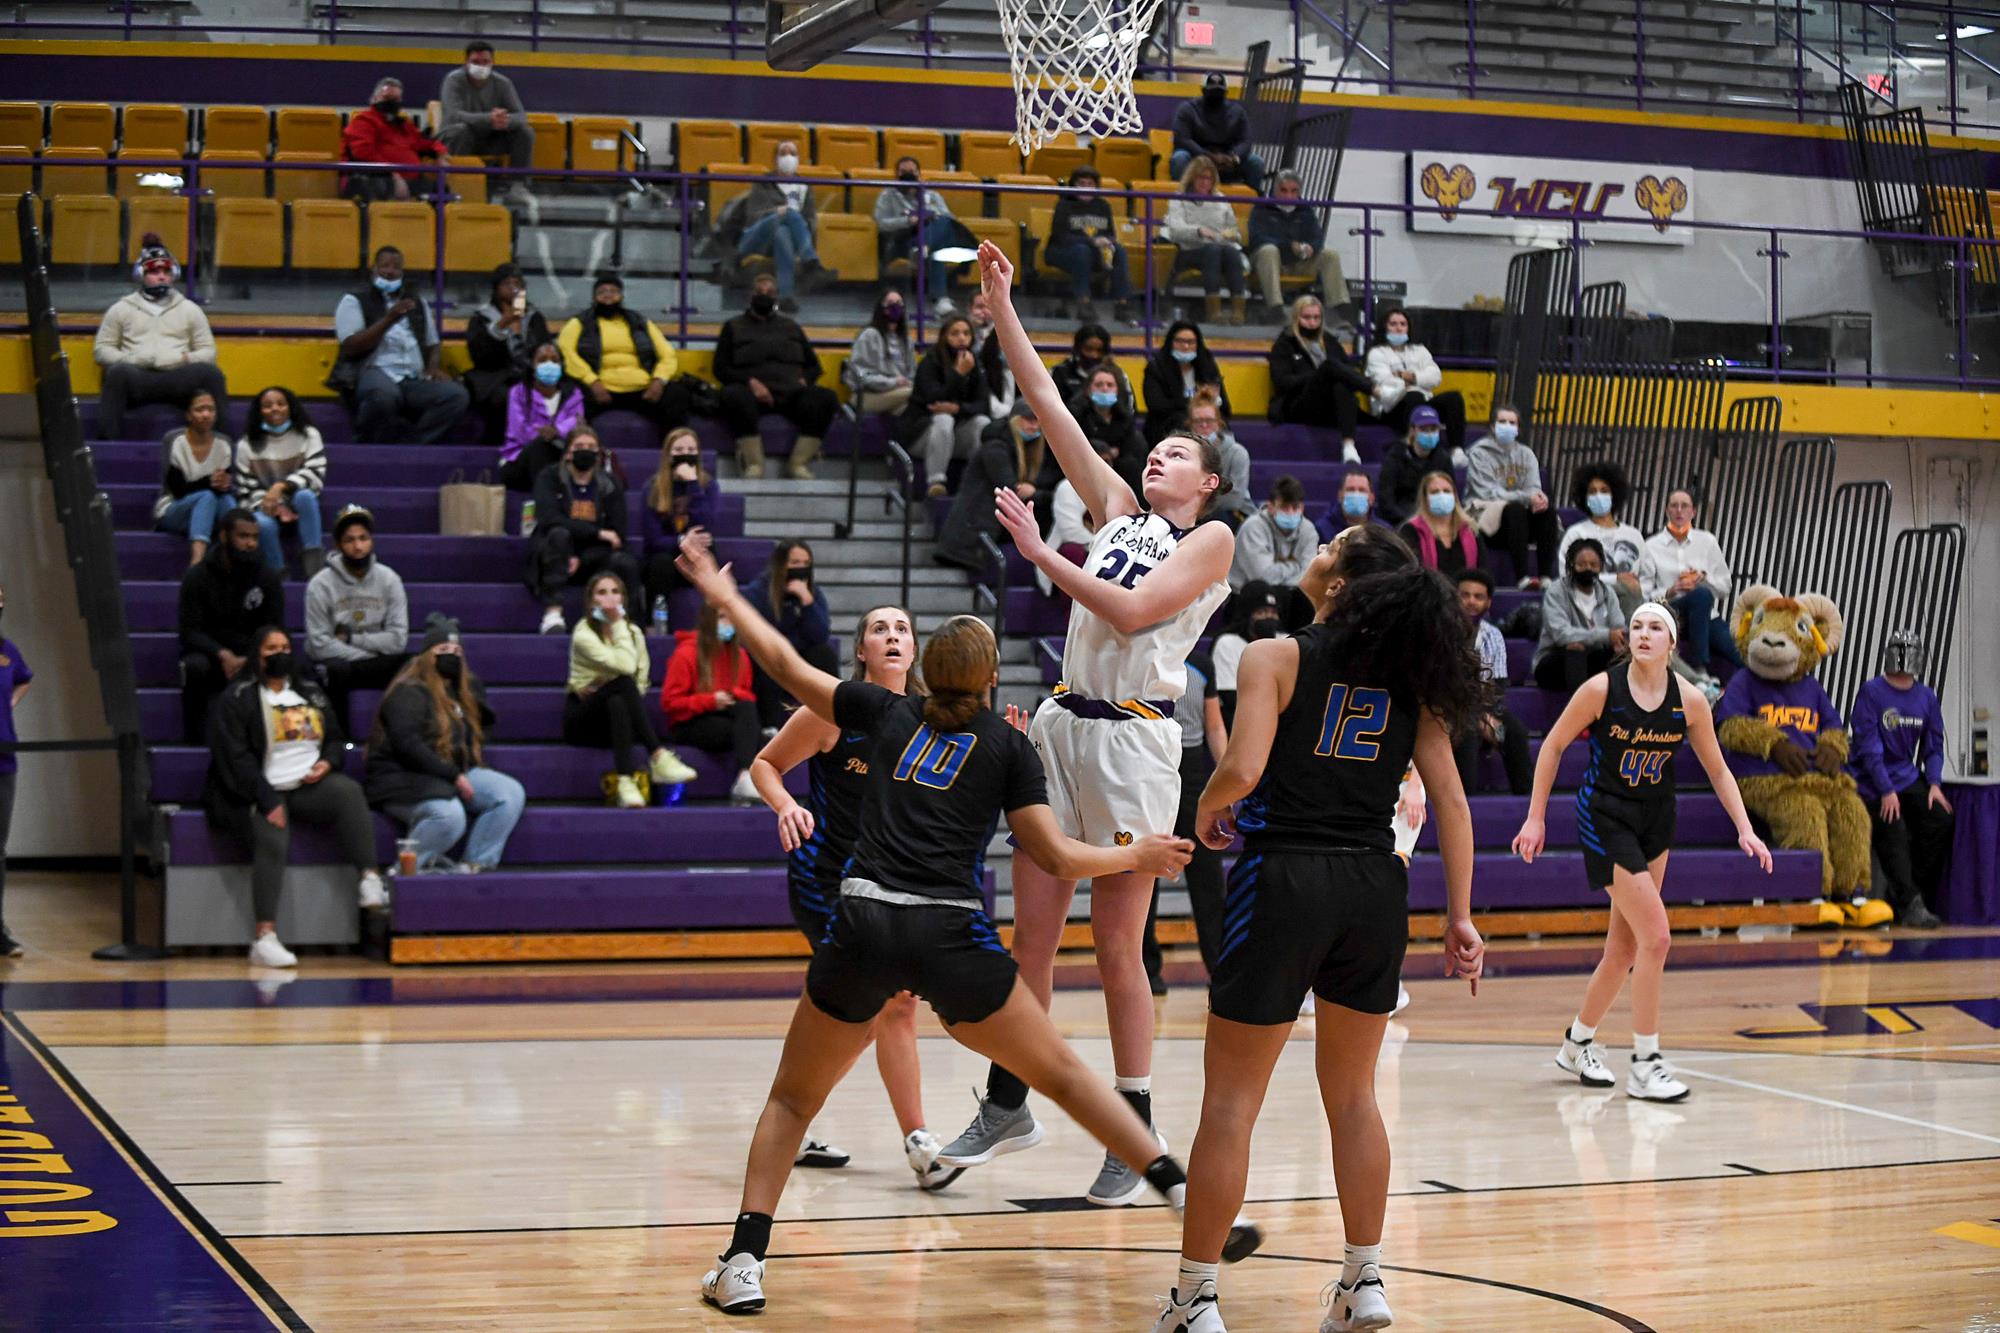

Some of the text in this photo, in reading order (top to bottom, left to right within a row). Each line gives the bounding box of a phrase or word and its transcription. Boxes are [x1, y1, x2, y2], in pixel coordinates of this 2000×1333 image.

[1487, 177, 1624, 220] WCU
[1314, 683, 1391, 761] 12
[1759, 703, 1819, 732] WCU
[893, 721, 978, 790] 10
[1620, 749, 1672, 787] 44
